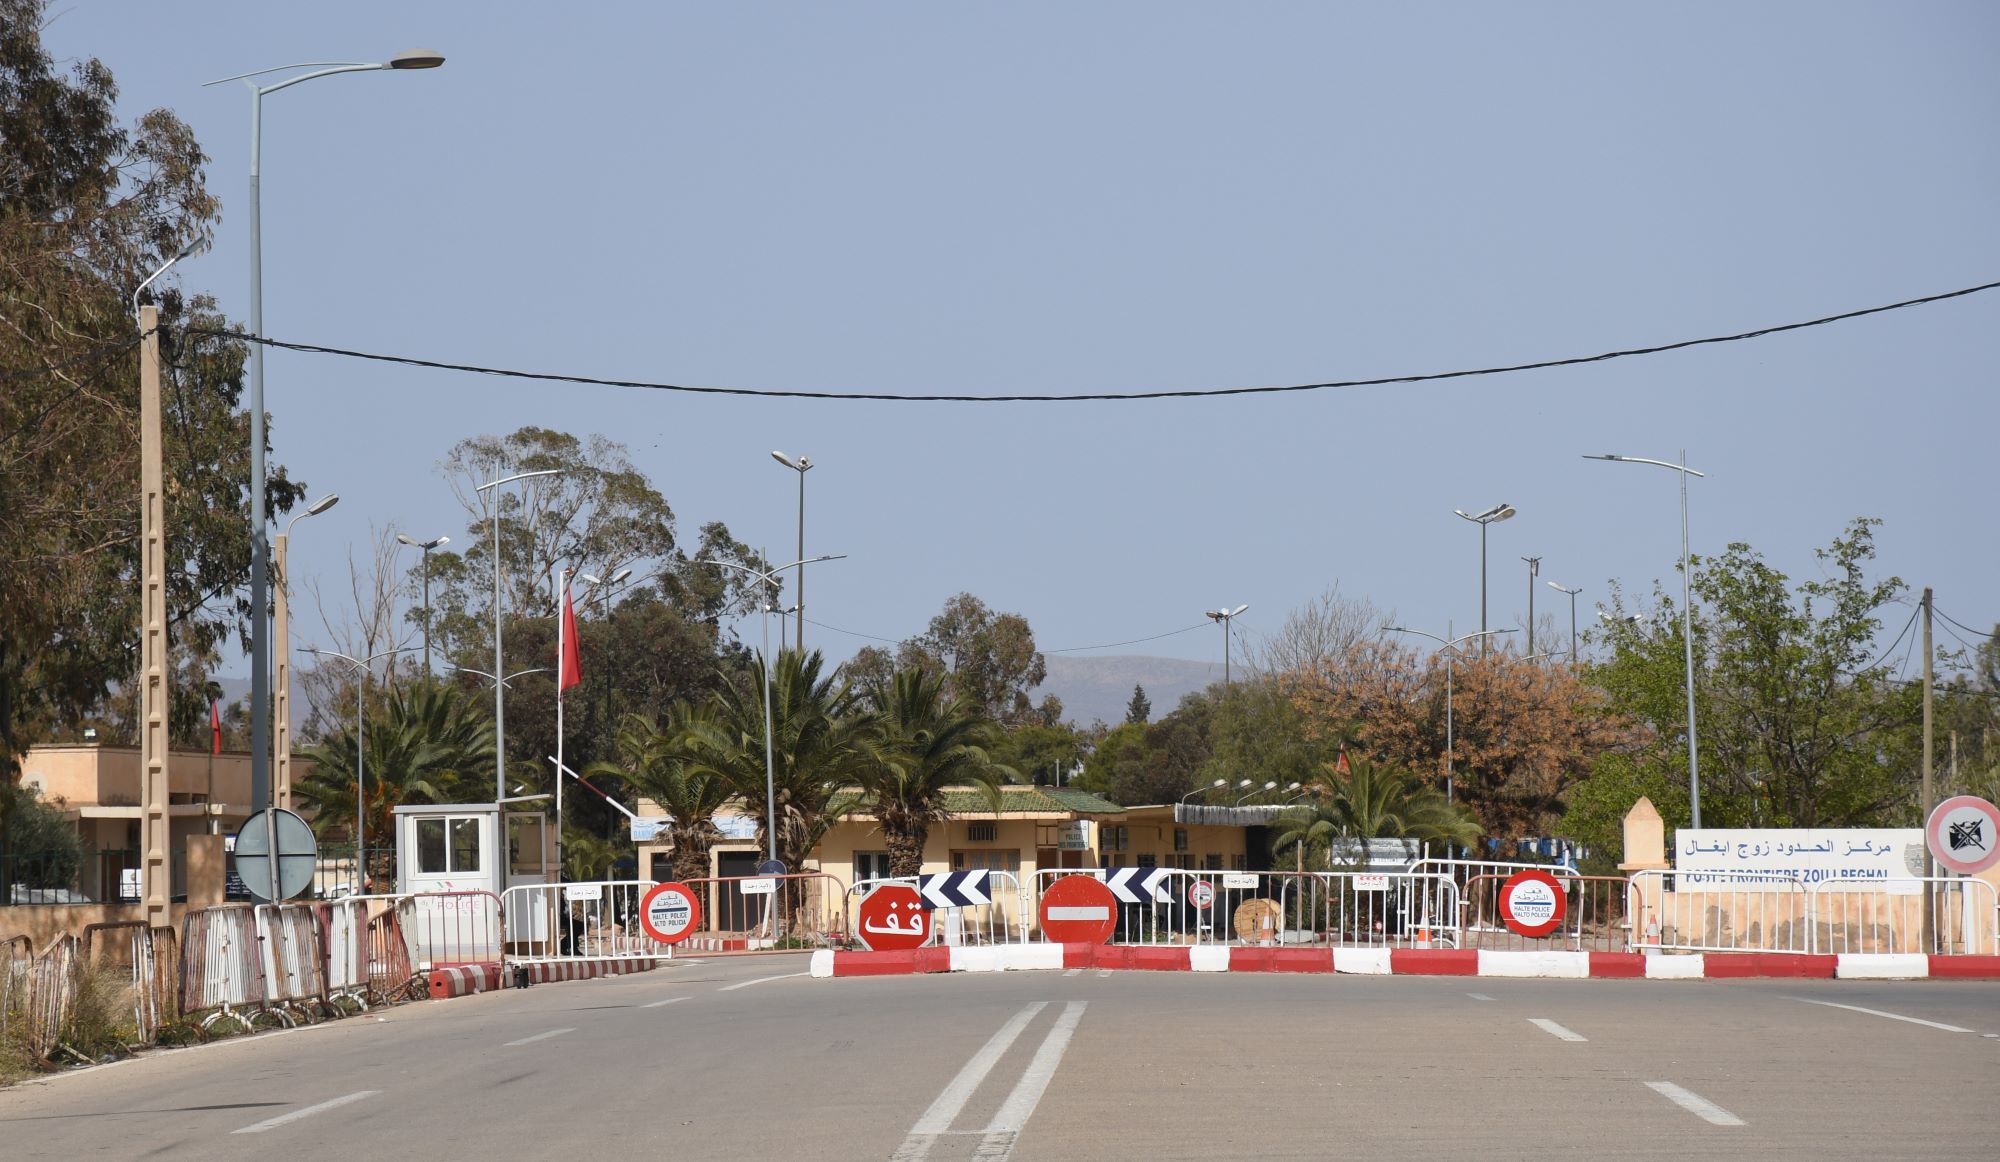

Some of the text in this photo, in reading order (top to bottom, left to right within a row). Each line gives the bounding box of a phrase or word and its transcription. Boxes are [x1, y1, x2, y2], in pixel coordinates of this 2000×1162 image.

[1737, 840, 1770, 858] زوج
[1777, 840, 1834, 857] الحدود
[1843, 840, 1891, 857] مركز
[437, 900, 480, 911] POLICE
[864, 900, 925, 937] قف
